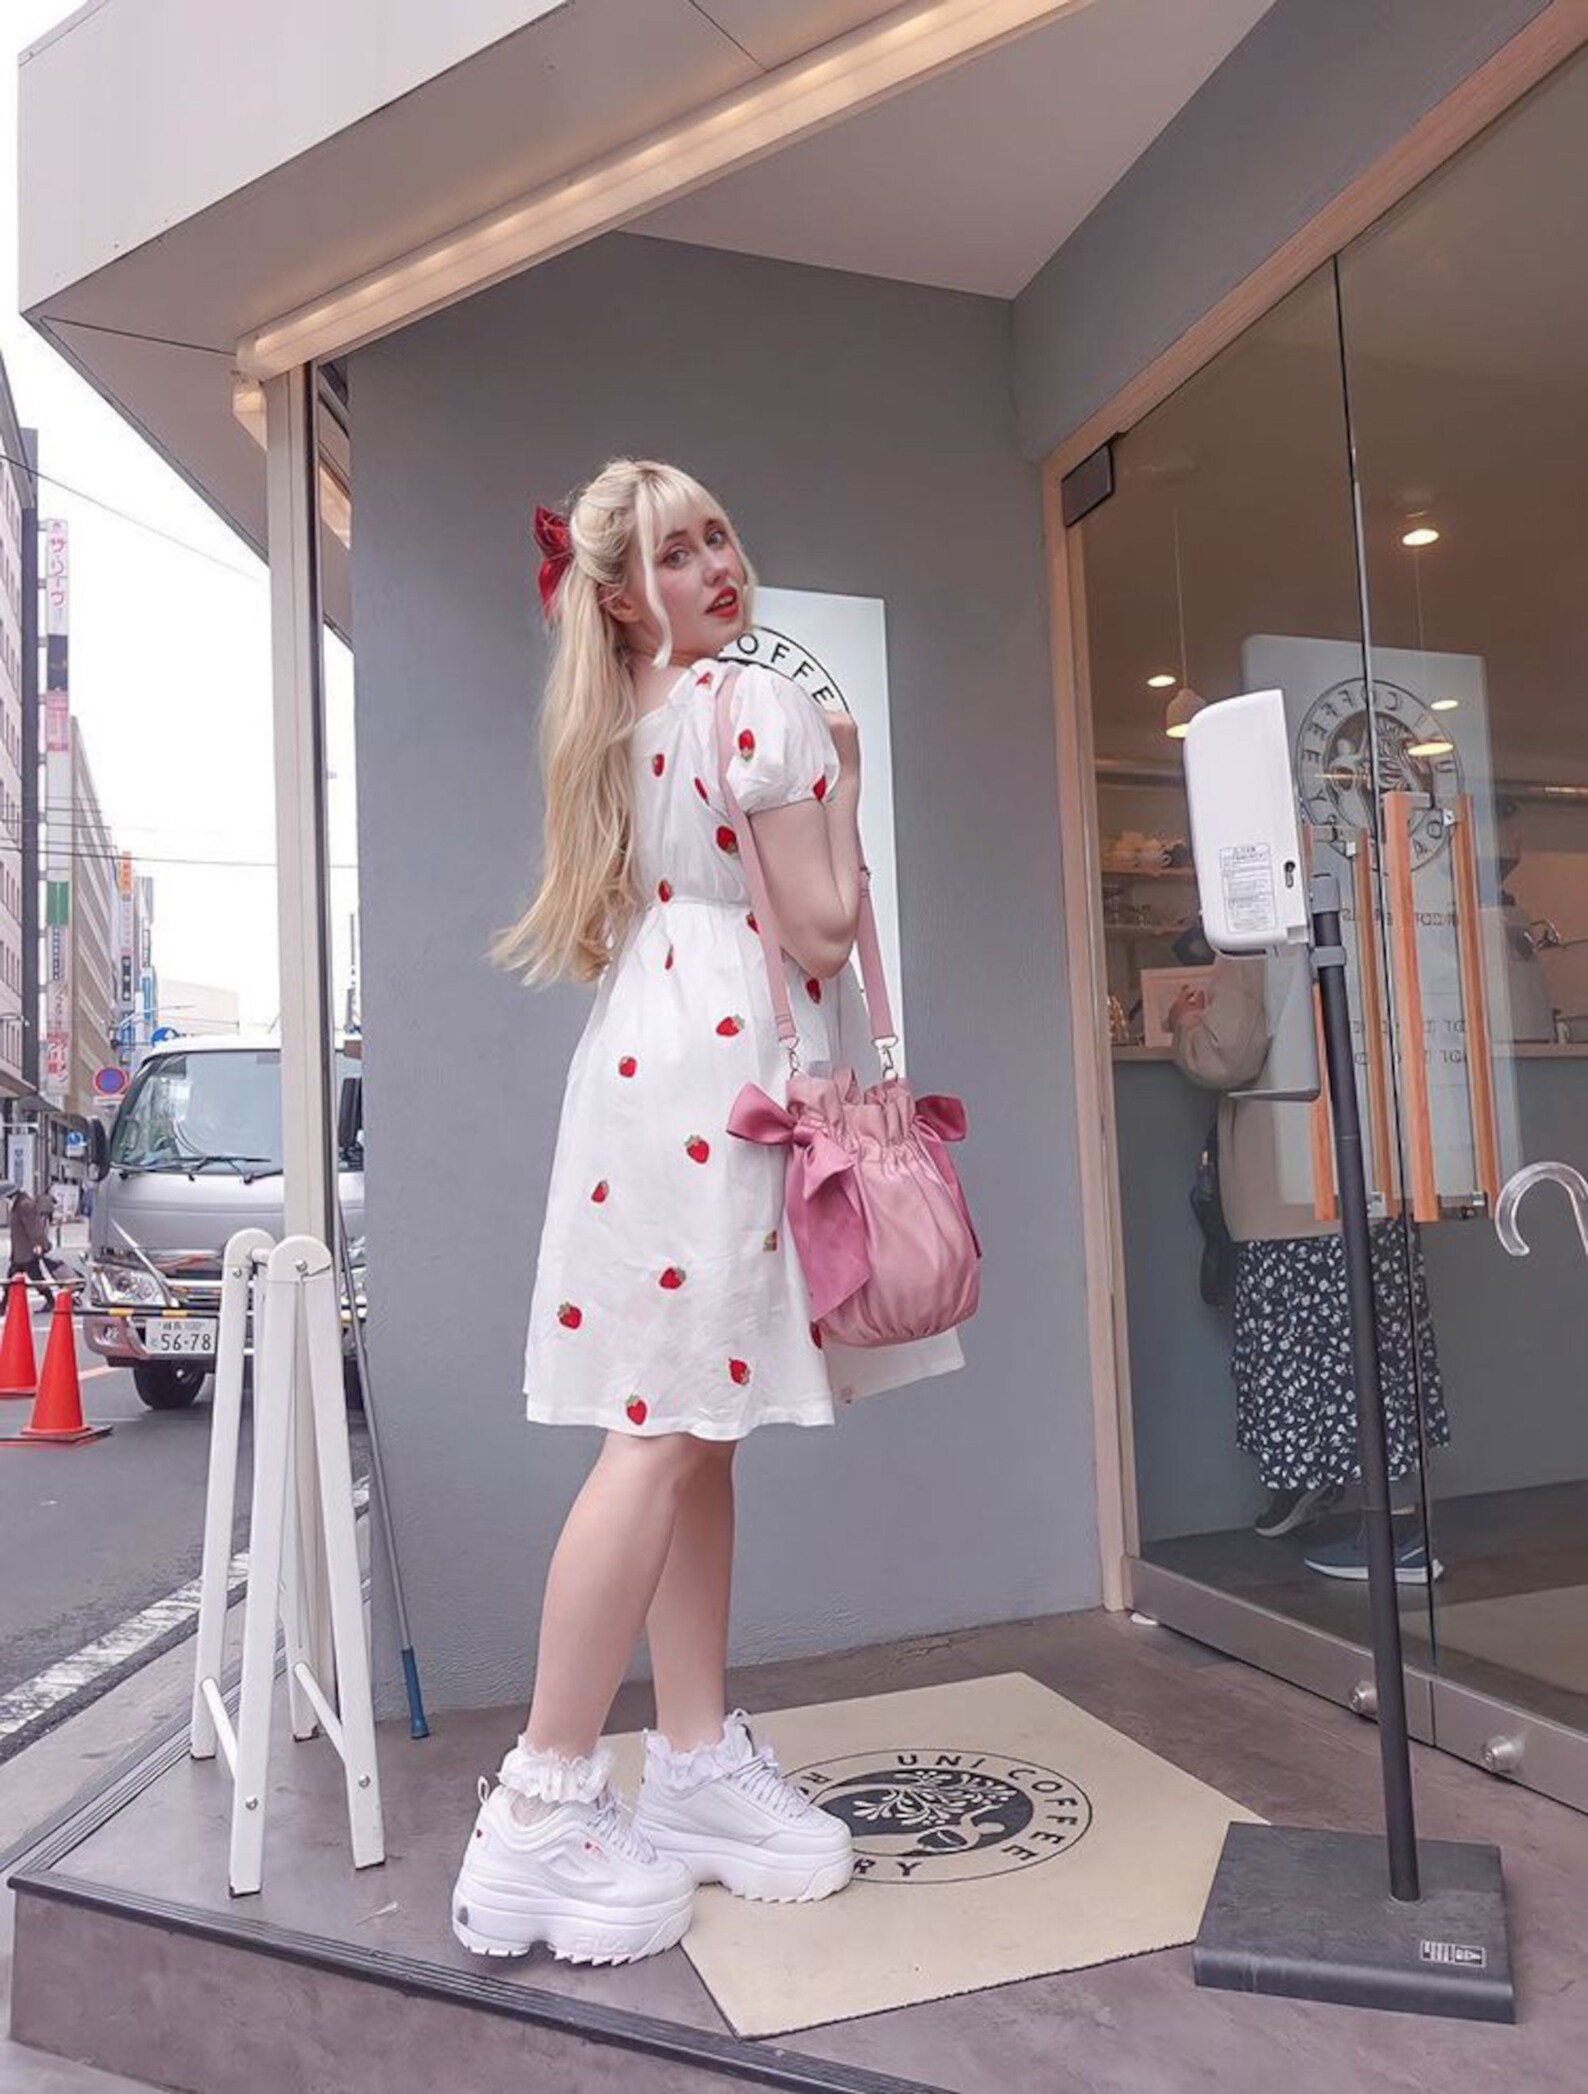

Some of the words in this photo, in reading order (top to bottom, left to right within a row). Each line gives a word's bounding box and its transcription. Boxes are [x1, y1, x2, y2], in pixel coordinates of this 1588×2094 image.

[736, 632, 836, 706] OFFE
[897, 1753, 987, 1769] UNI
[1001, 1767, 1079, 1862] COFFEE
